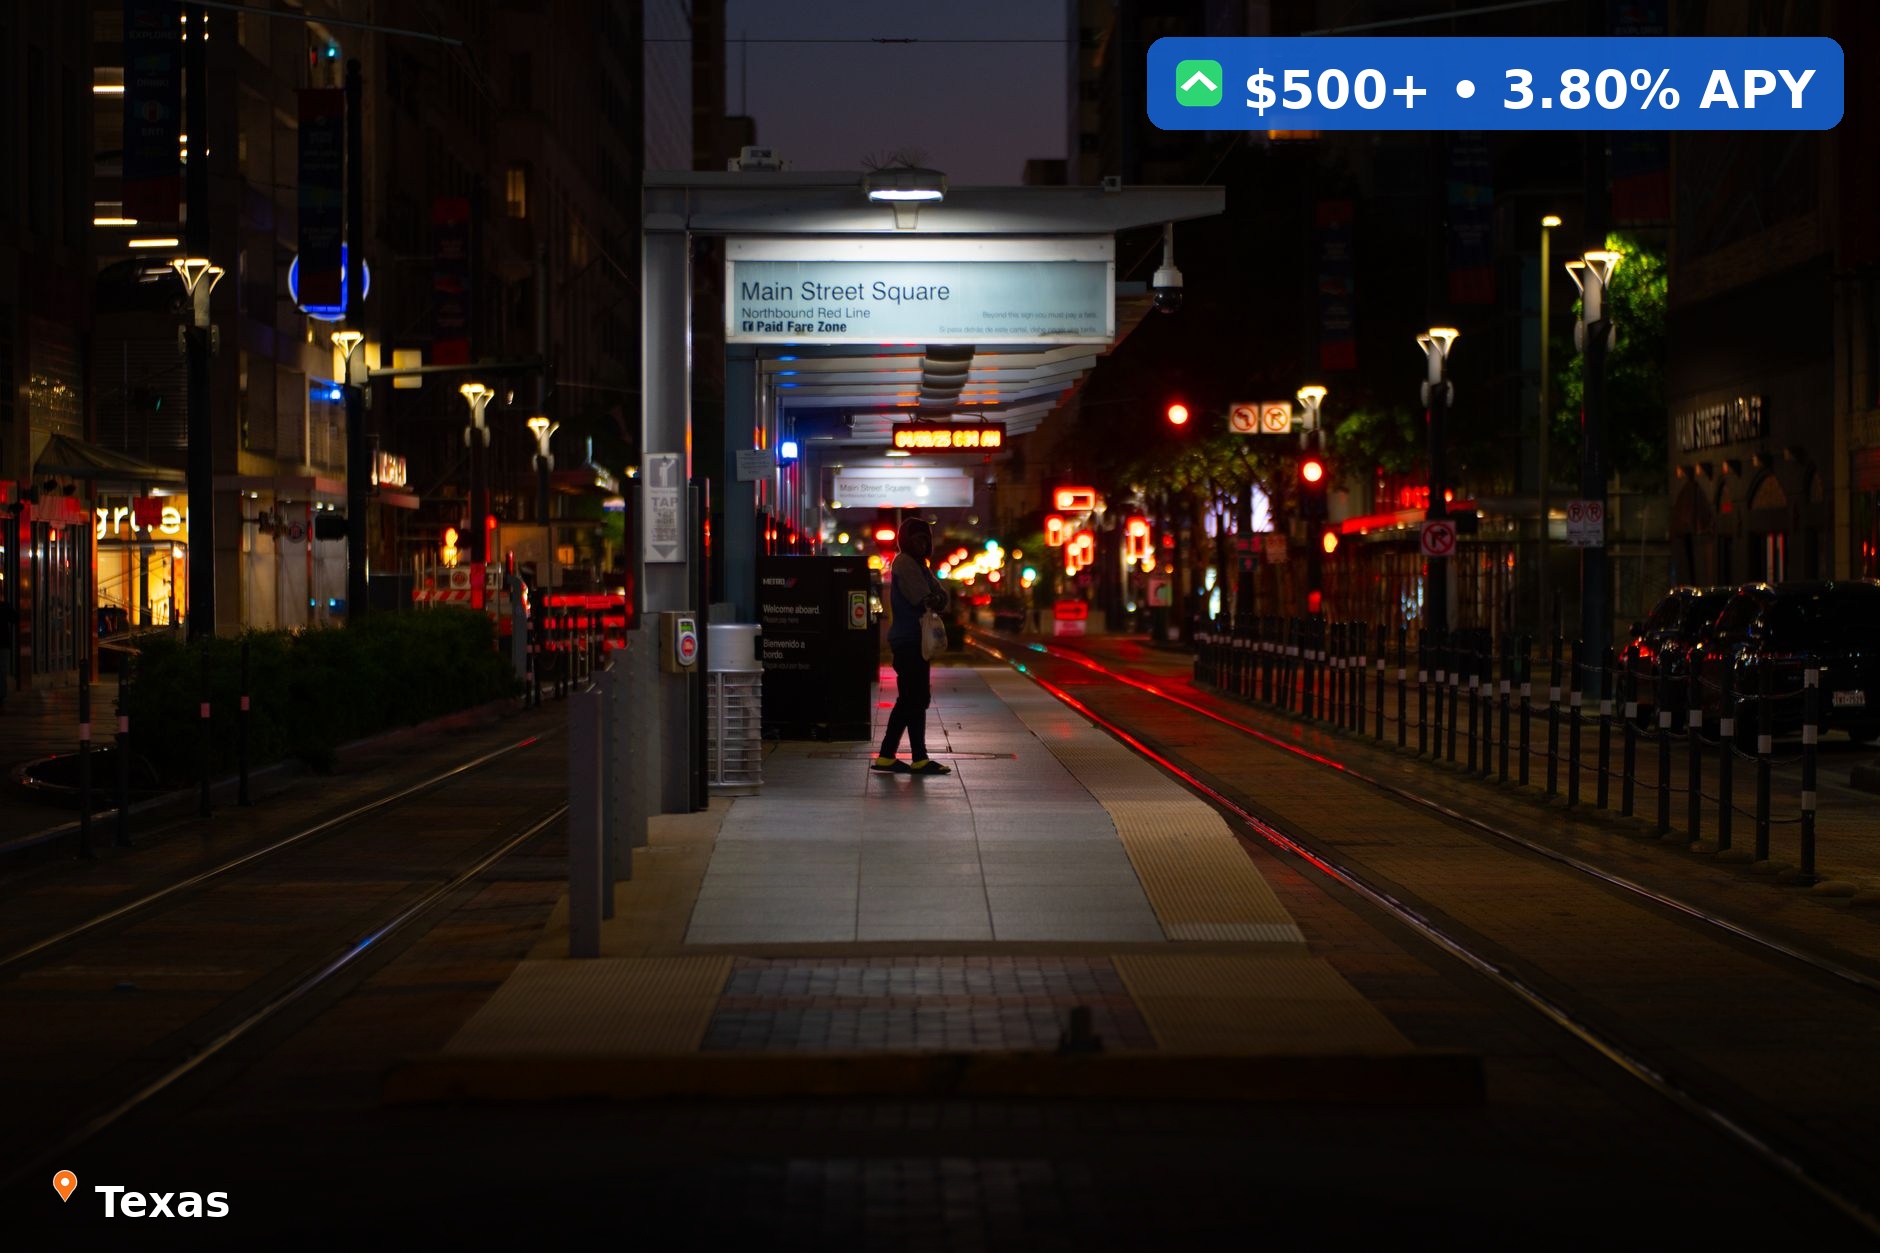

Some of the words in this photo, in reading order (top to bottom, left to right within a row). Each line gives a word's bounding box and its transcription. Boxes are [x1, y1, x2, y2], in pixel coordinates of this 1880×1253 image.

[741, 282, 793, 301] Main
[801, 281, 865, 301] Street
[872, 281, 950, 305] Square
[742, 307, 814, 318] Northbound
[818, 307, 841, 318] Red
[845, 307, 871, 318] Line
[982, 312, 1007, 321] Beyond
[1021, 312, 1034, 321] sign
[756, 321, 783, 332] Paid
[787, 321, 814, 332] Fare
[817, 321, 847, 332] Zone
[840, 484, 860, 492] Main
[861, 484, 883, 492] Street
[651, 498, 679, 508] TAP
[763, 578, 785, 586] METRO
[763, 604, 795, 614] Welcome
[795, 605, 821, 615] aboard.
[763, 639, 800, 649] Bienvenido
[800, 641, 806, 649] a
[763, 650, 785, 659] bordo.
